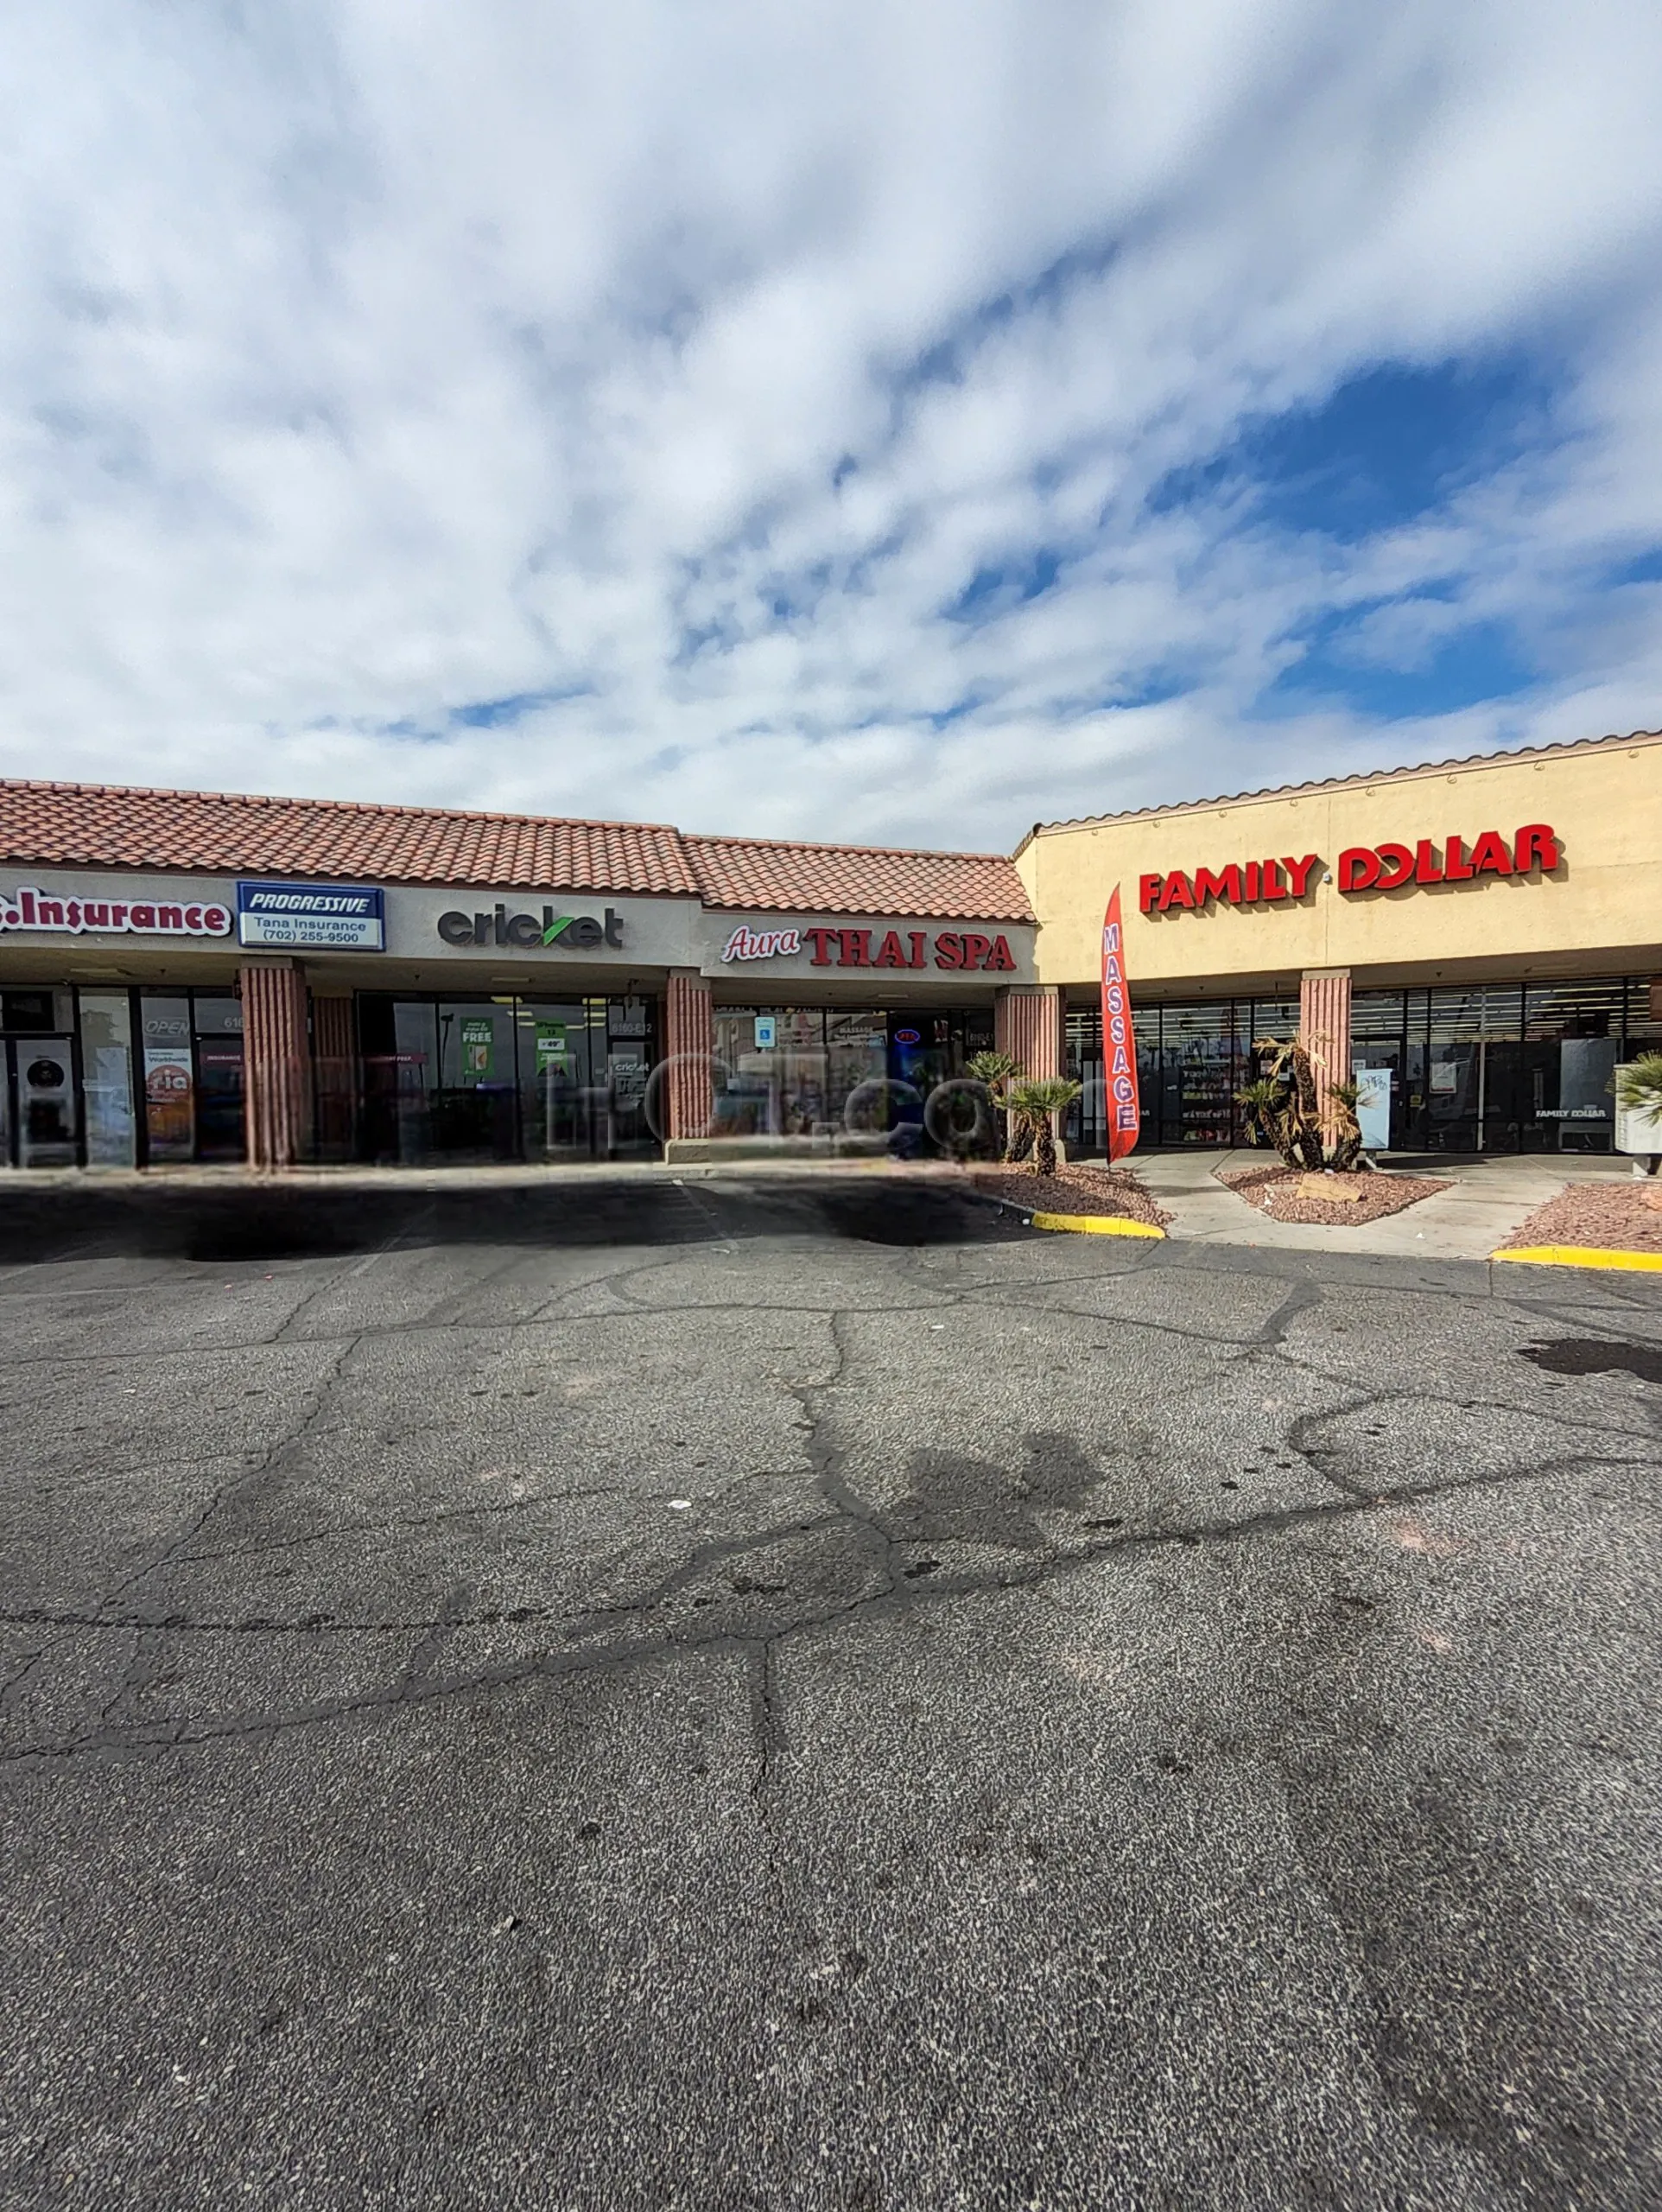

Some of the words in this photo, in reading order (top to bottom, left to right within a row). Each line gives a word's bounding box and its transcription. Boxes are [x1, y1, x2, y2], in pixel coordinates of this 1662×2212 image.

[1139, 854, 1318, 912] FAMILY
[1338, 823, 1558, 893] DOLLAR
[250, 893, 371, 913] PROGRESSIVE
[254, 917, 290, 929] Tana
[295, 918, 366, 932] Insurance
[263, 929, 297, 944] (702)
[300, 931, 359, 943] 255-9500
[437, 904, 624, 948] cricket
[723, 927, 799, 960] Aura
[803, 928, 928, 969] THAI
[934, 932, 1018, 971] SPA
[462, 1032, 492, 1042] FREE
[1103, 923, 1138, 1131] MASSAGE
